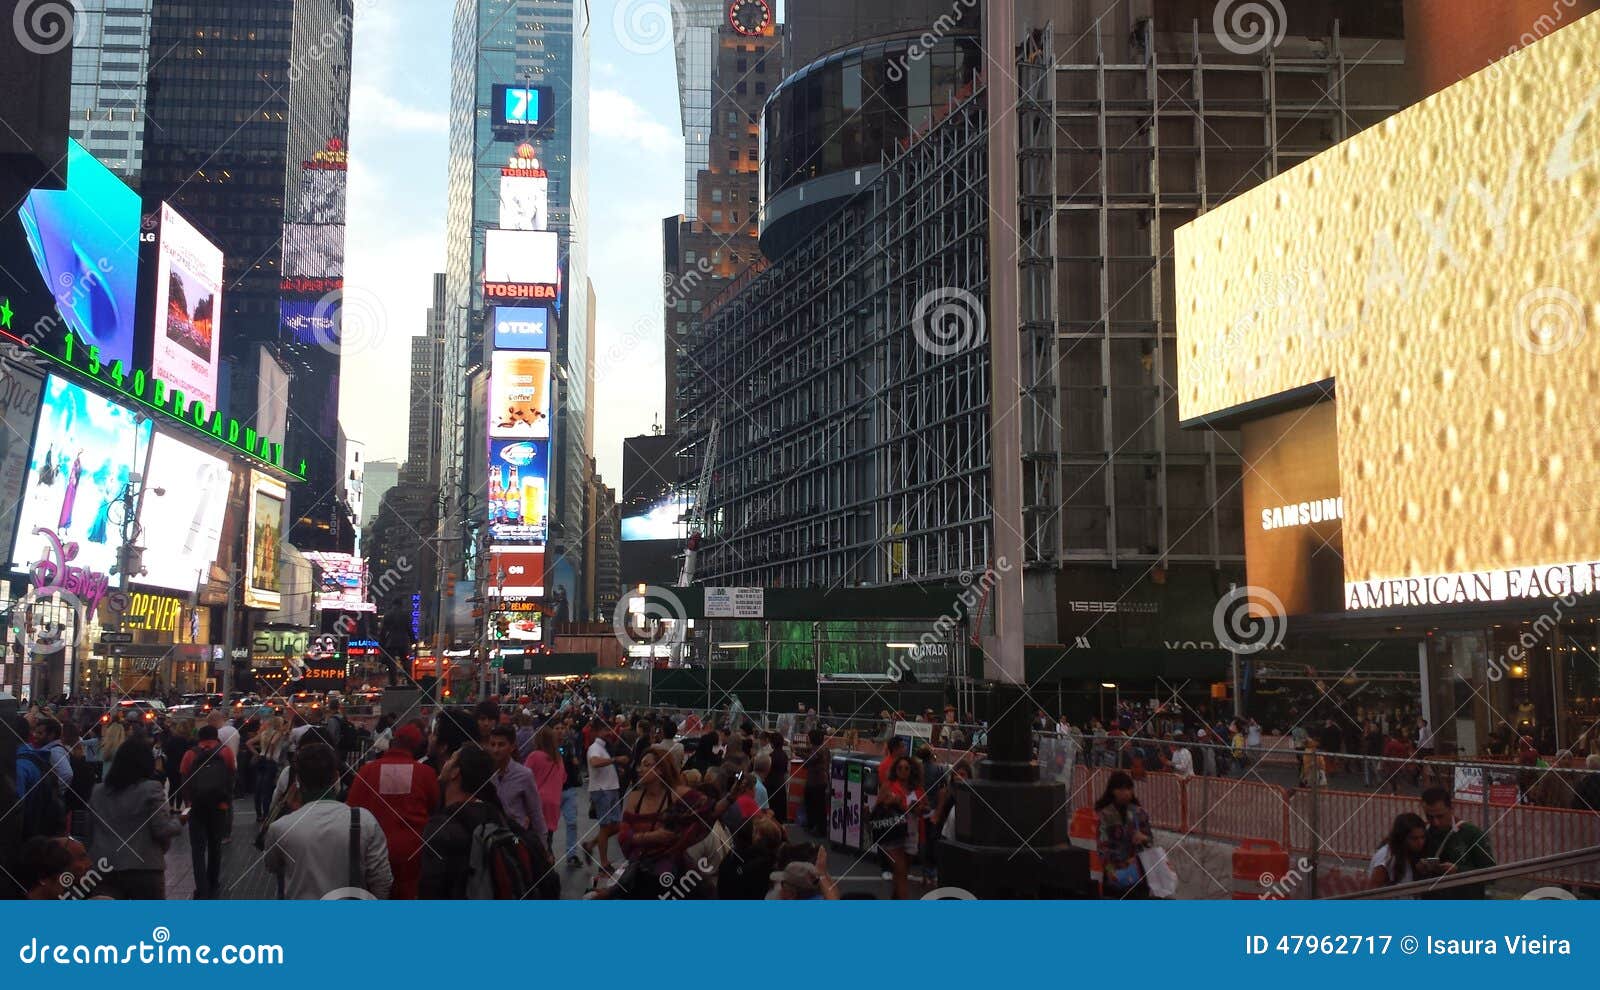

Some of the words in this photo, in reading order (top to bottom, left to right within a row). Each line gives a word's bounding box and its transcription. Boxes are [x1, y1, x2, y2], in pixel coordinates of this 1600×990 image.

[512, 89, 533, 119] 7
[502, 168, 546, 178] TOSHIBA
[139, 232, 156, 242] LG
[485, 284, 556, 298] TOSHIBA
[508, 321, 544, 334] TDK
[64, 333, 145, 396] 1540
[153, 379, 282, 465] BROADWAY
[1349, 572, 1492, 610] AMERICAN
[1504, 562, 1600, 599] EAGLE
[121, 592, 179, 632] OREVER
[1069, 601, 1117, 613] 1535
[872, 815, 907, 828] XPRESS
